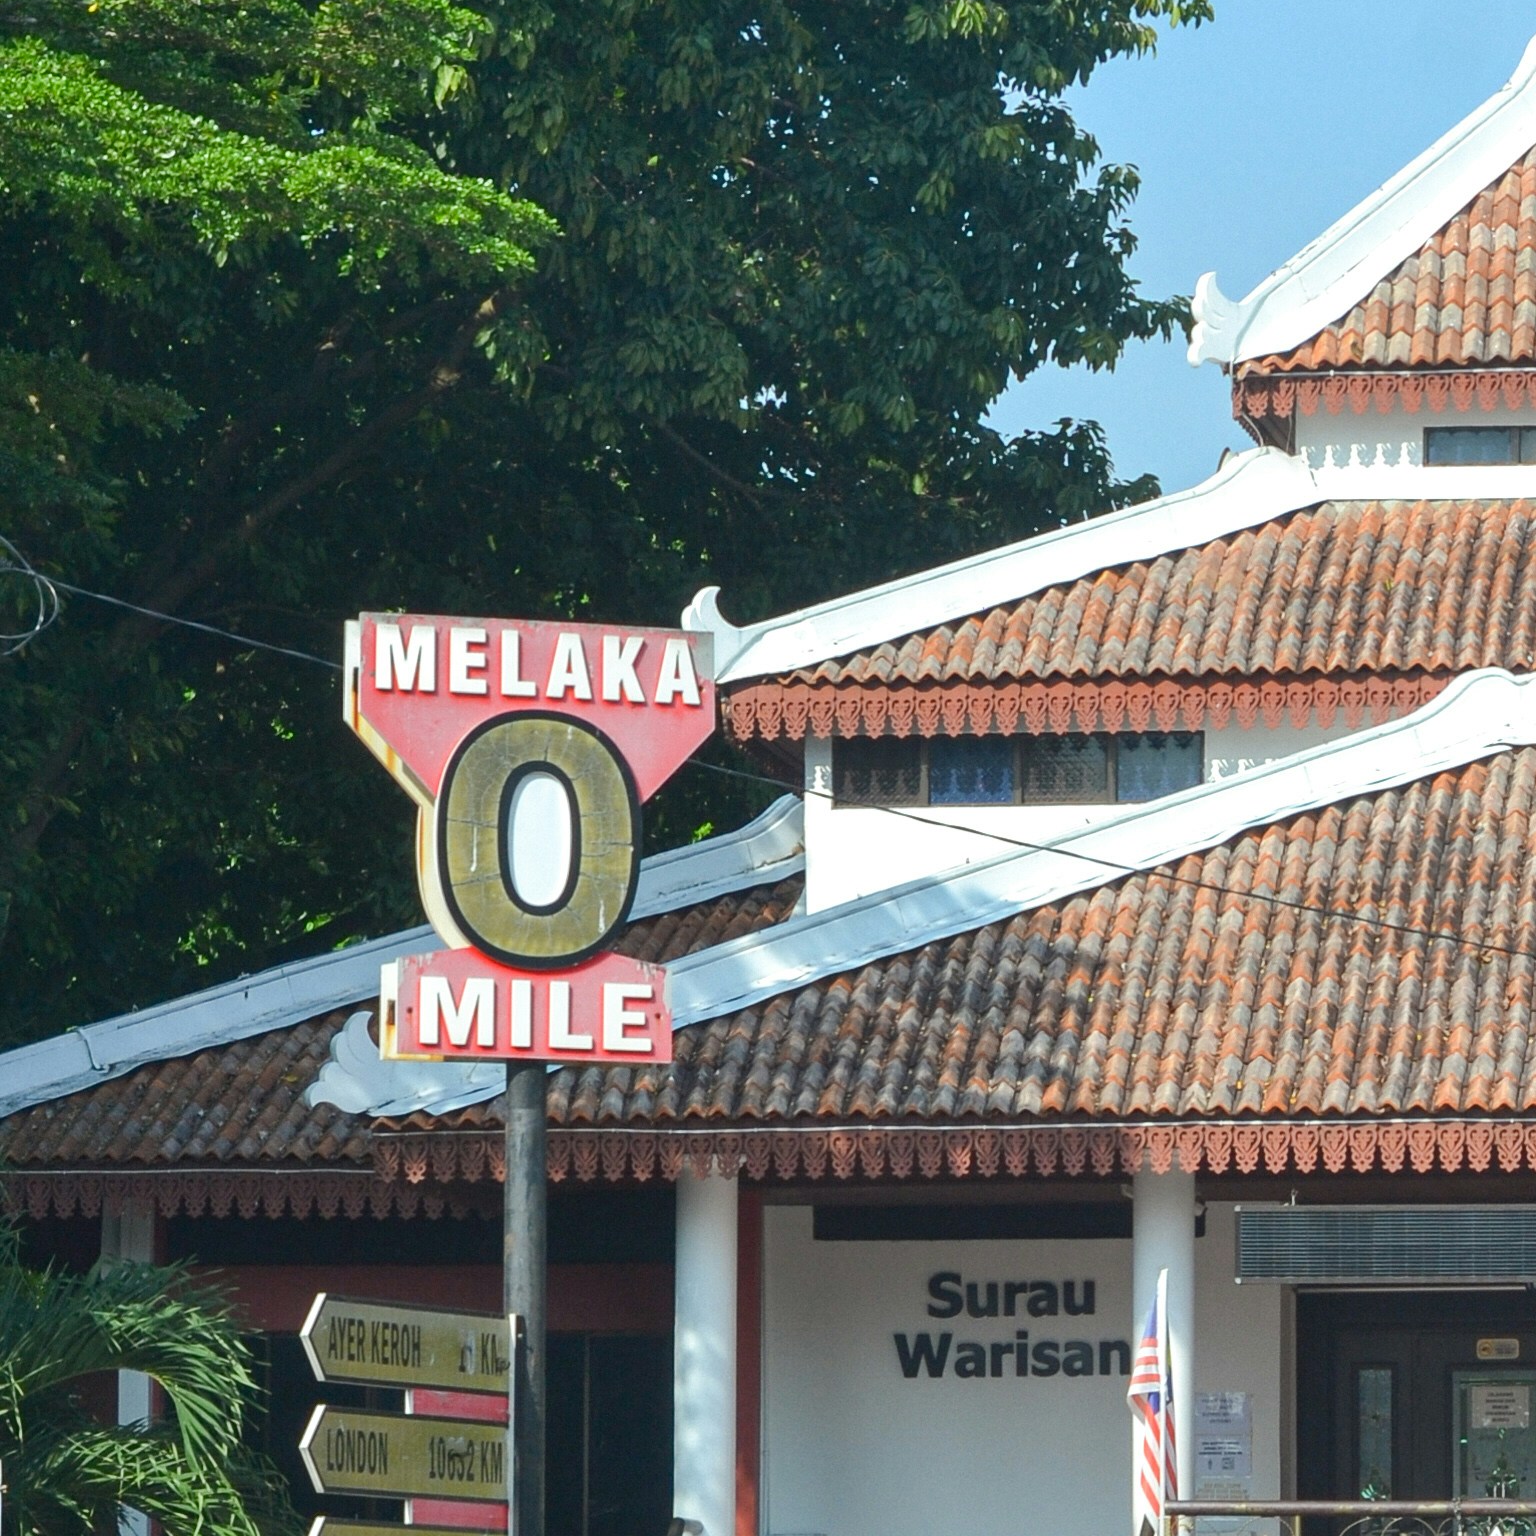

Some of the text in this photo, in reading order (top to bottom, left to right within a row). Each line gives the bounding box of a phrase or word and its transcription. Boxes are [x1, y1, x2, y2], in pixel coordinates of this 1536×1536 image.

[375, 623, 701, 705] MELAKA
[419, 976, 653, 1052] MILE
[926, 1271, 1096, 1318] Surau
[327, 1316, 366, 1362] AYER
[370, 1319, 421, 1368] KEROH
[893, 1330, 1131, 1378] Warisan
[327, 1427, 388, 1476] LONDON
[480, 1440, 503, 1484] KM
